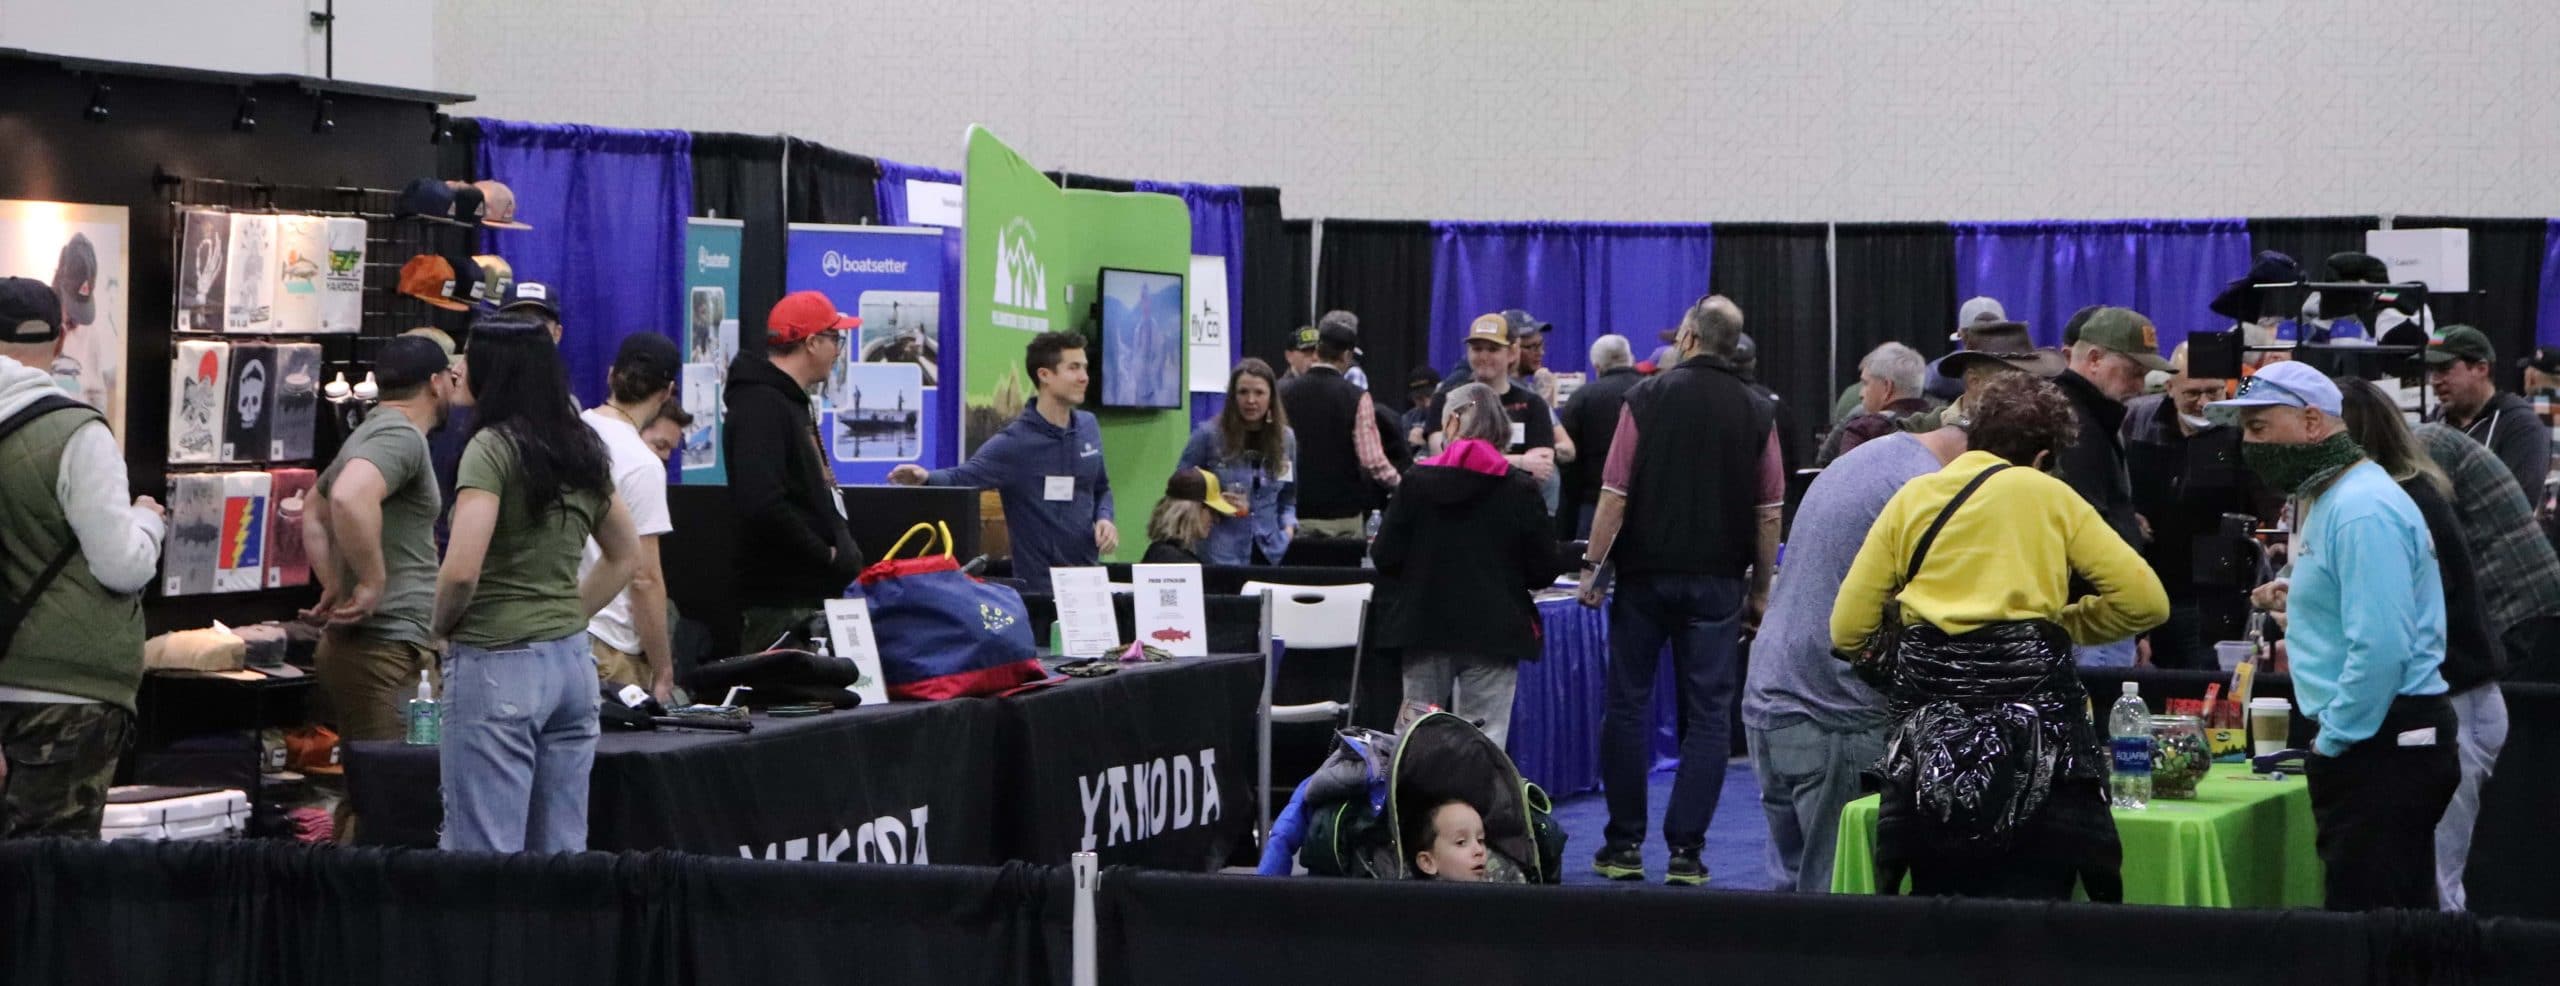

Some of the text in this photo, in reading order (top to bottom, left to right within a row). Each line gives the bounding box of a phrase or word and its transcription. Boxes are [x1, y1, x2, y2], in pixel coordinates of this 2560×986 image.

[843, 257, 908, 273] boatsetter
[2116, 751, 2149, 762] AQUAFIN
[1079, 748, 1220, 851] YAKODA
